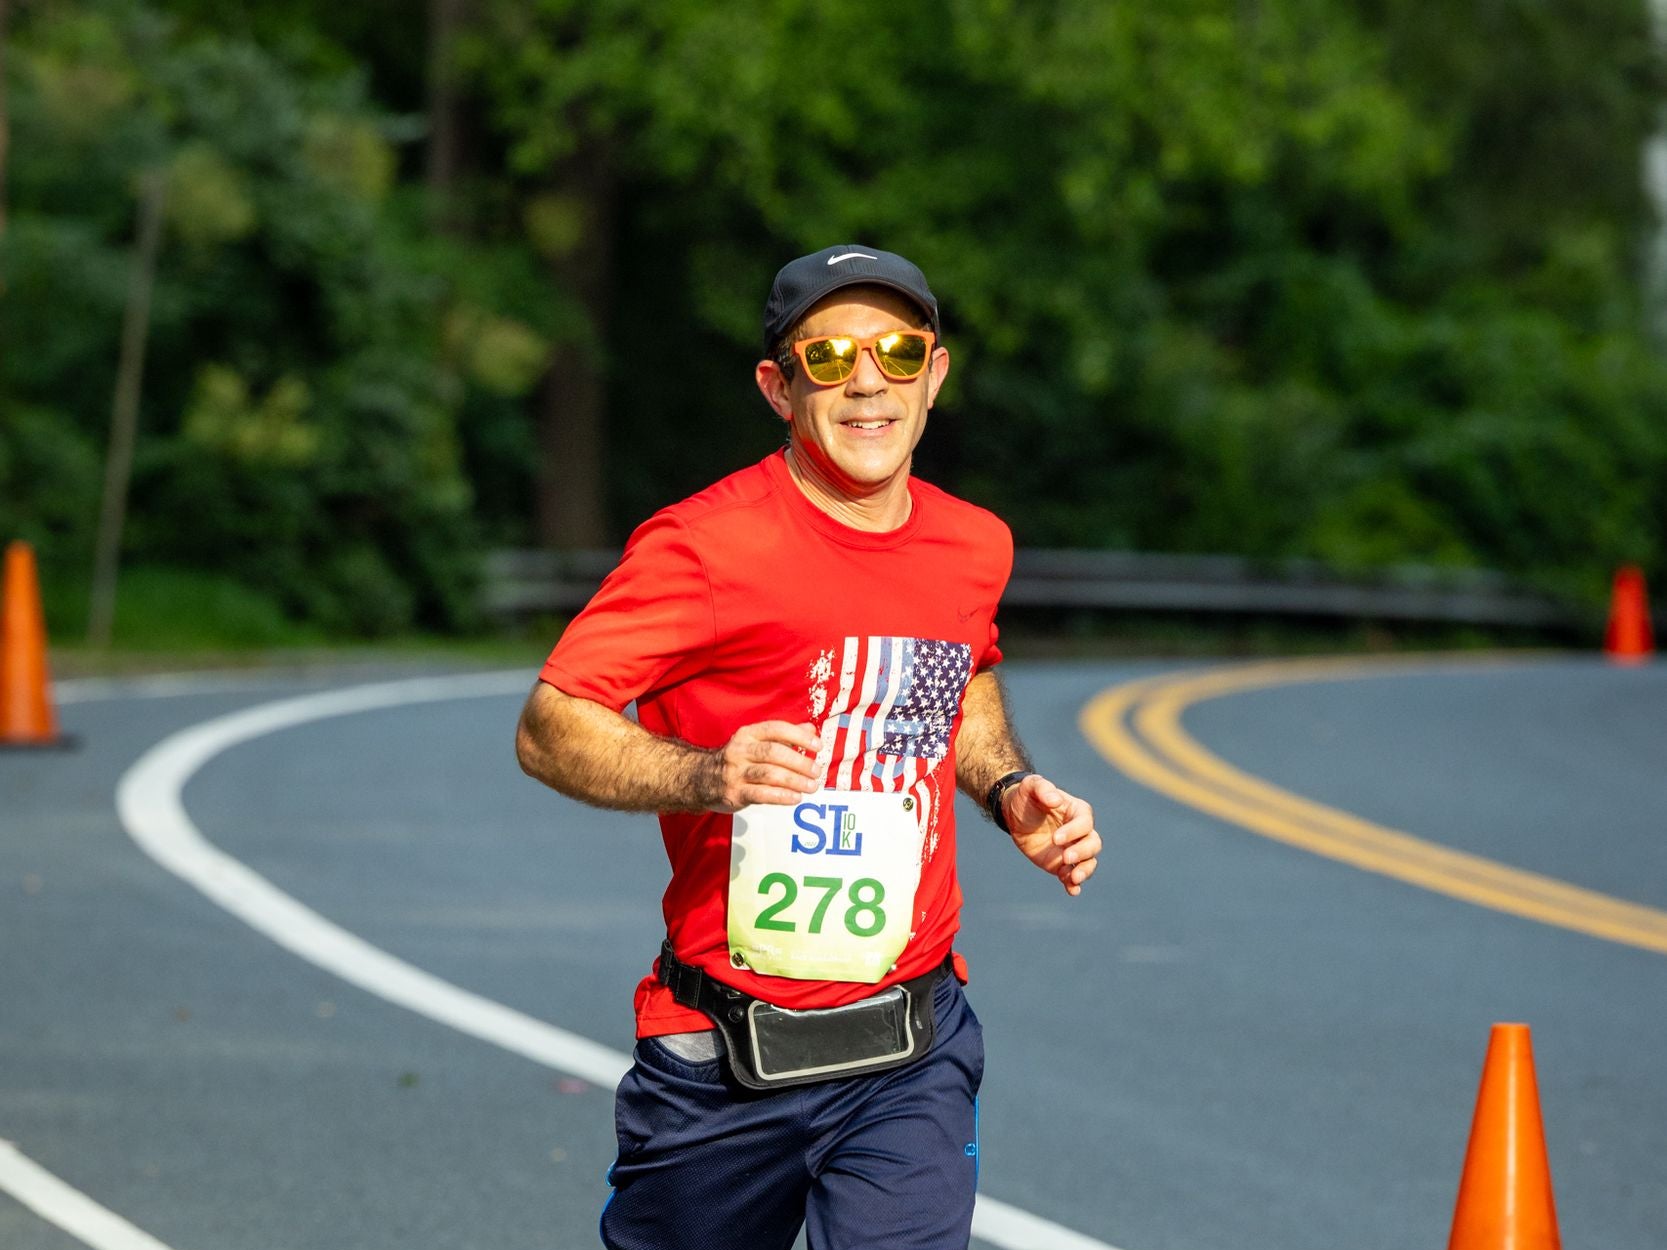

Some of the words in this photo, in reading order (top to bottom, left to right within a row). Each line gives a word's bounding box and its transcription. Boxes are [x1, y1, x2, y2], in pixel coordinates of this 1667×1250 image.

[791, 802, 863, 856] SL
[841, 831, 851, 848] K
[754, 872, 886, 938] 278
